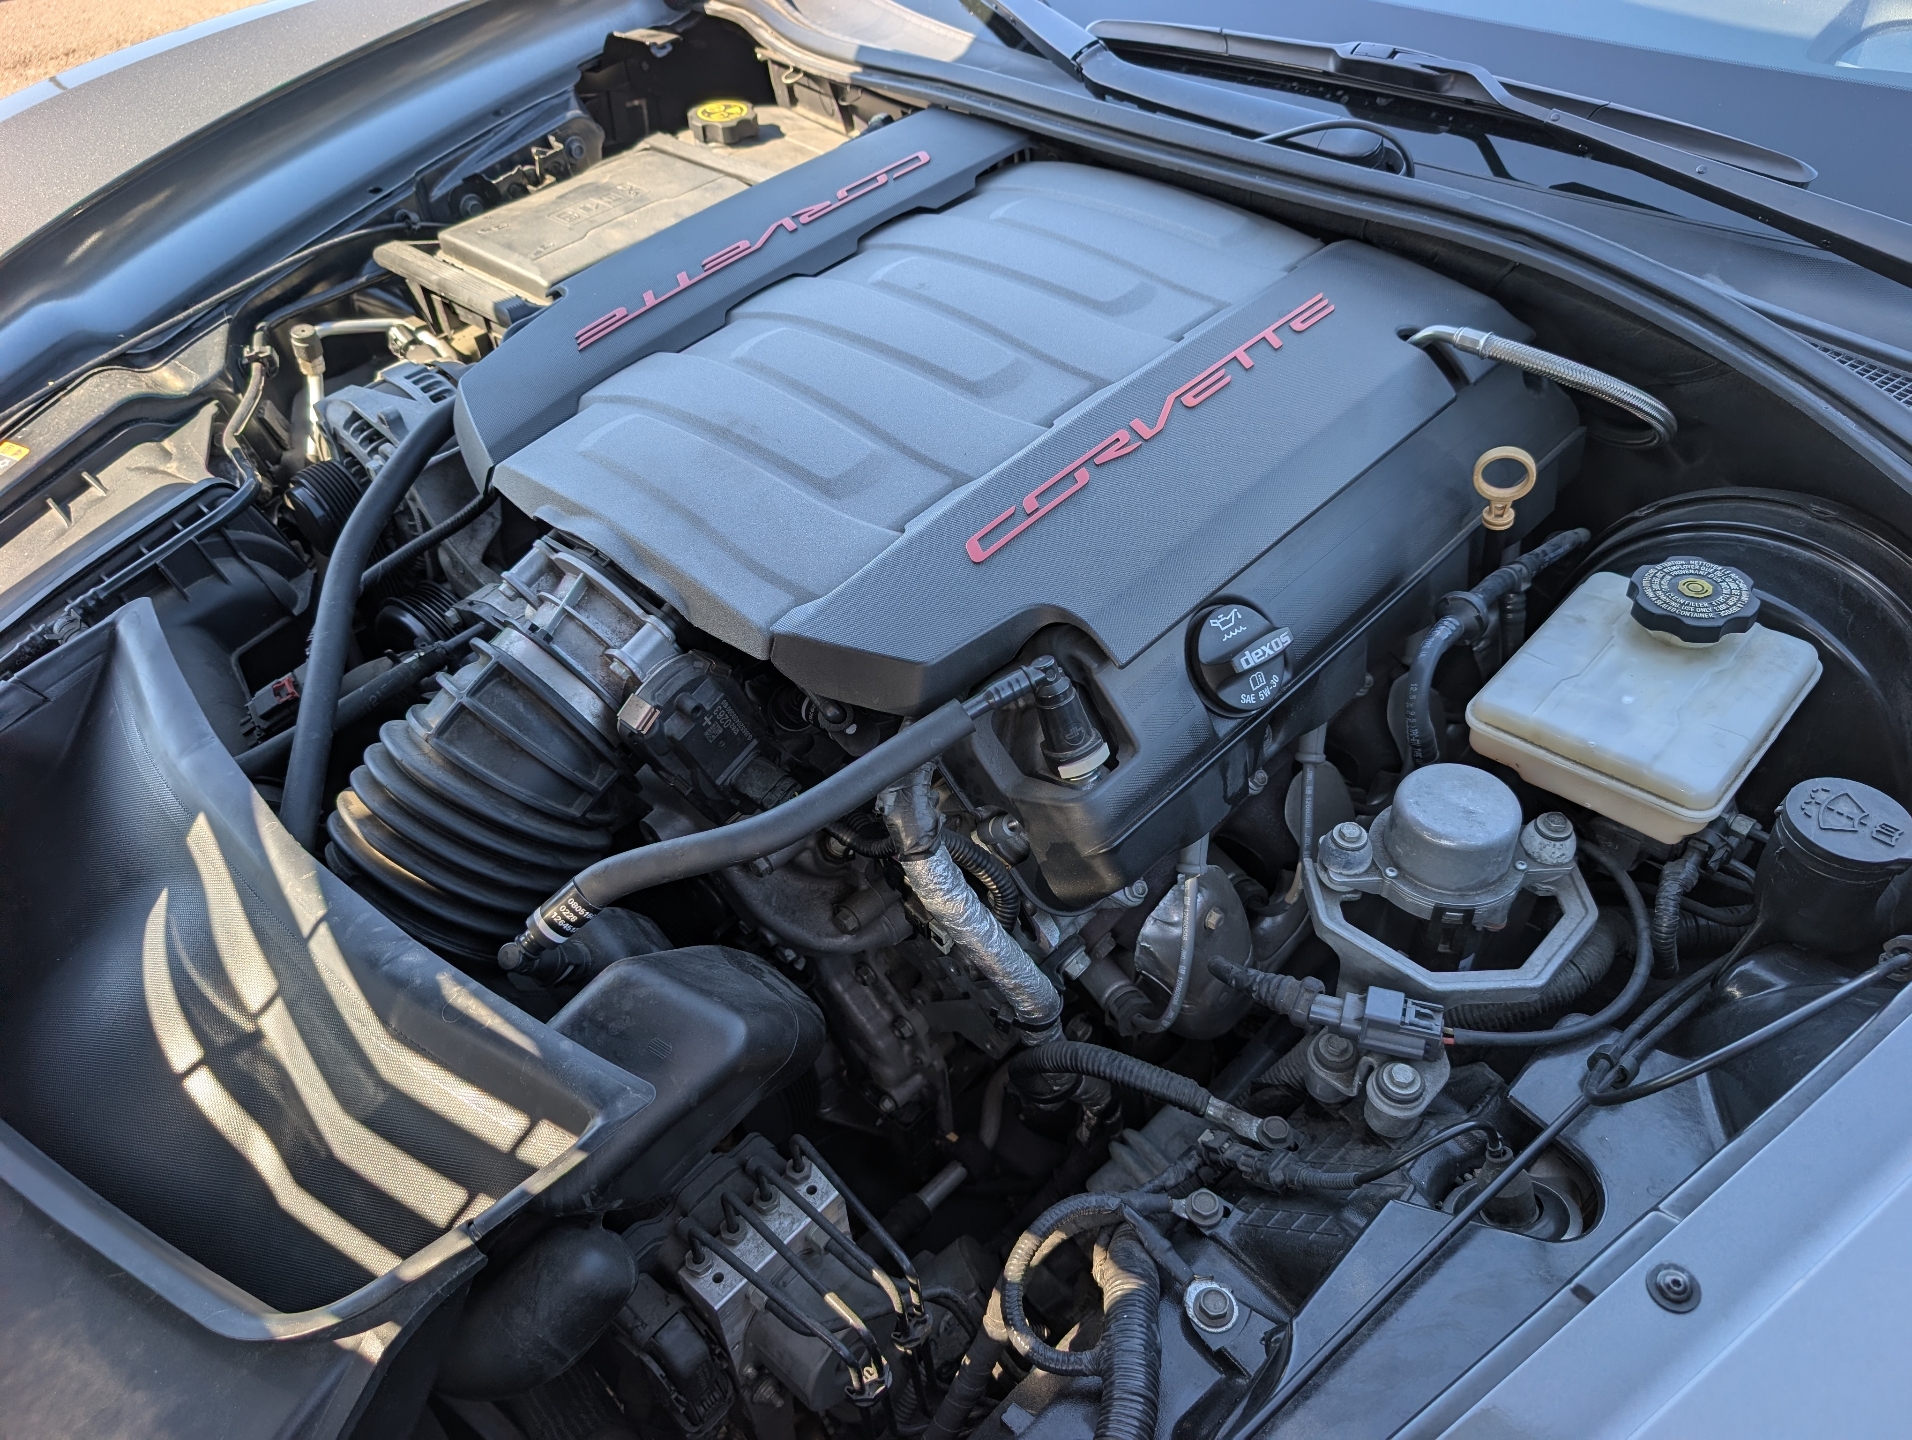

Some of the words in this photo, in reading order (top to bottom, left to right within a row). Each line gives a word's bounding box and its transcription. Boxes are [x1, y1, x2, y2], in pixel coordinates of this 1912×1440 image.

[575, 151, 930, 351] CORVETTE
[965, 292, 1335, 563] CORVETTE
[1240, 631, 1291, 670] dexos
[1240, 693, 1256, 704] SAE
[1258, 674, 1280, 701] 5W-30
[559, 904, 578, 922] 0228
